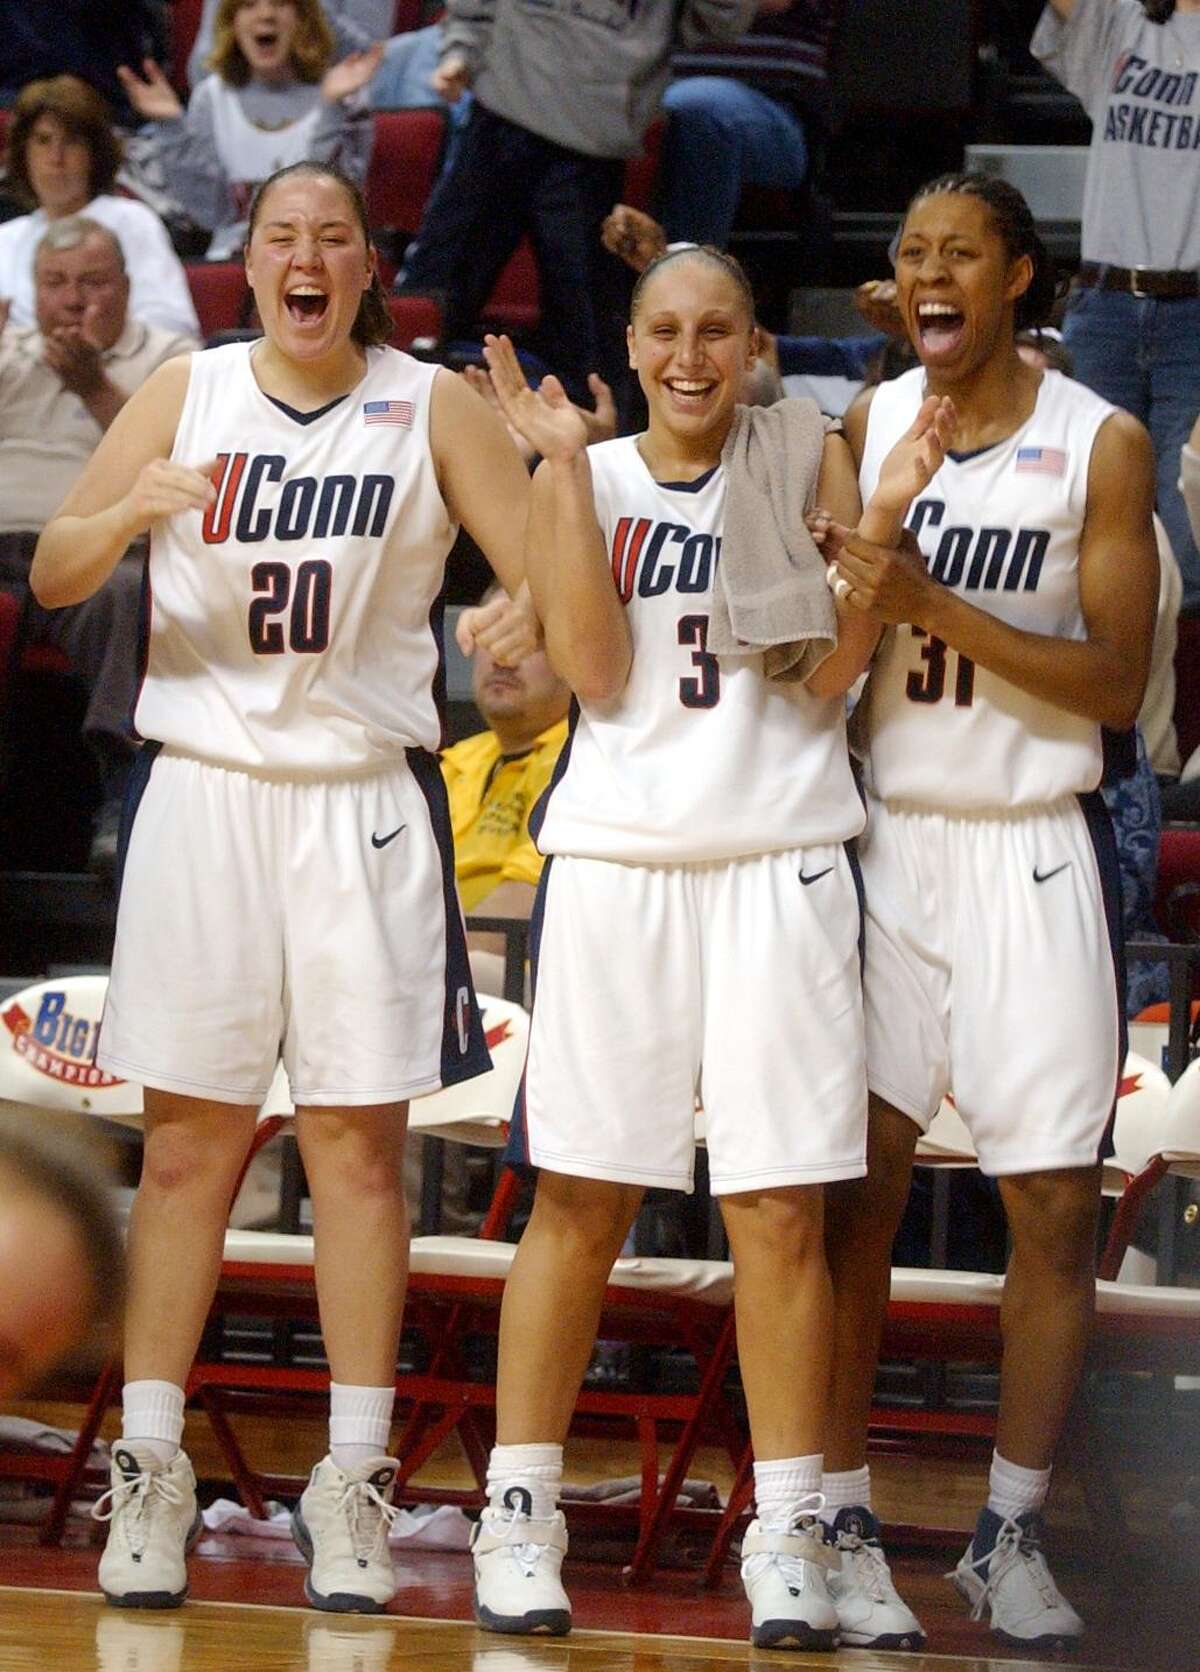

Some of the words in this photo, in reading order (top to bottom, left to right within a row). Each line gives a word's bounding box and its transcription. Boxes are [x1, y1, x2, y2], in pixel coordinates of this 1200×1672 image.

[202, 453, 395, 544] UConn
[248, 559, 332, 654] 20
[611, 517, 722, 606] UCo
[677, 614, 720, 709] 3
